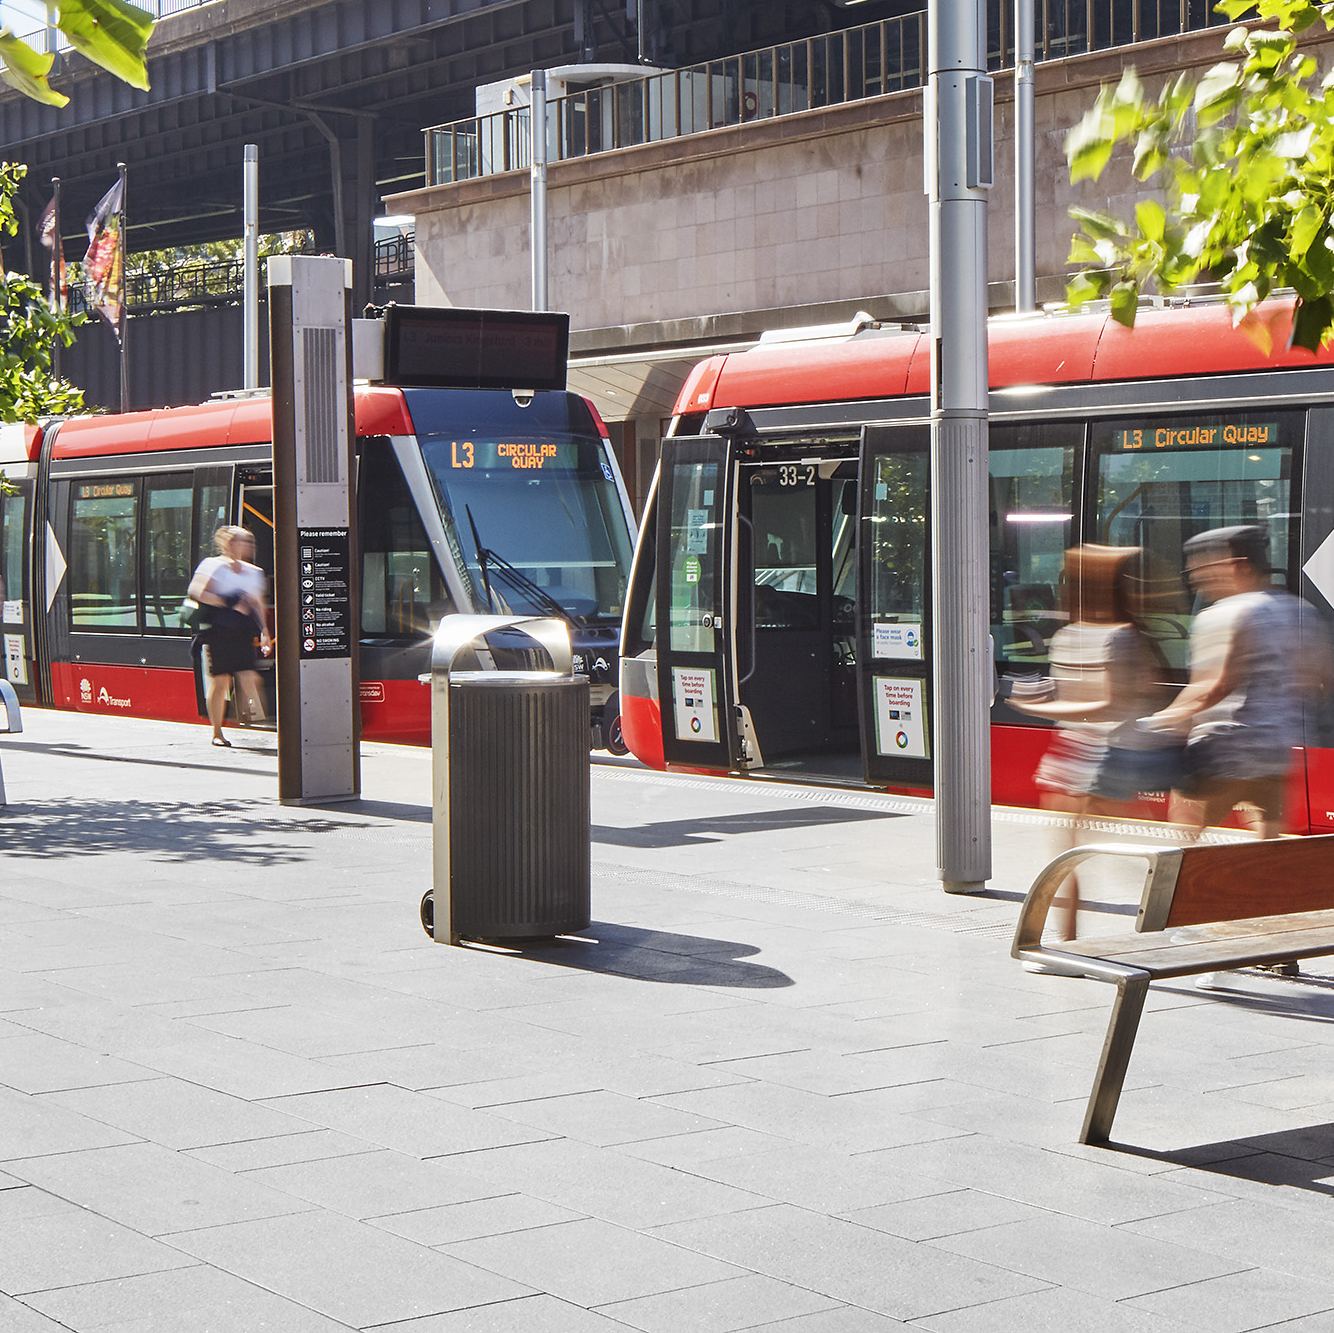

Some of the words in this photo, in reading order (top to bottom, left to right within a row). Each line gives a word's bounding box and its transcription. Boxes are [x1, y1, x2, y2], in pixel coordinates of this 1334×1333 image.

[1123, 430, 1143, 449] L3
[1155, 427, 1217, 447] Circular
[1223, 425, 1269, 444] Quay
[452, 442, 474, 468] L3
[497, 444, 557, 457] CIRCULAR
[512, 456, 544, 468] QUAY
[779, 466, 815, 486] 33-2
[82, 486, 89, 498] L3
[93, 485, 114, 497] Circular
[116, 484, 131, 496] Quay
[109, 696, 131, 708] Transport
[889, 699, 910, 707] boarding
[1137, 795, 1166, 803] GOVERNMENT
